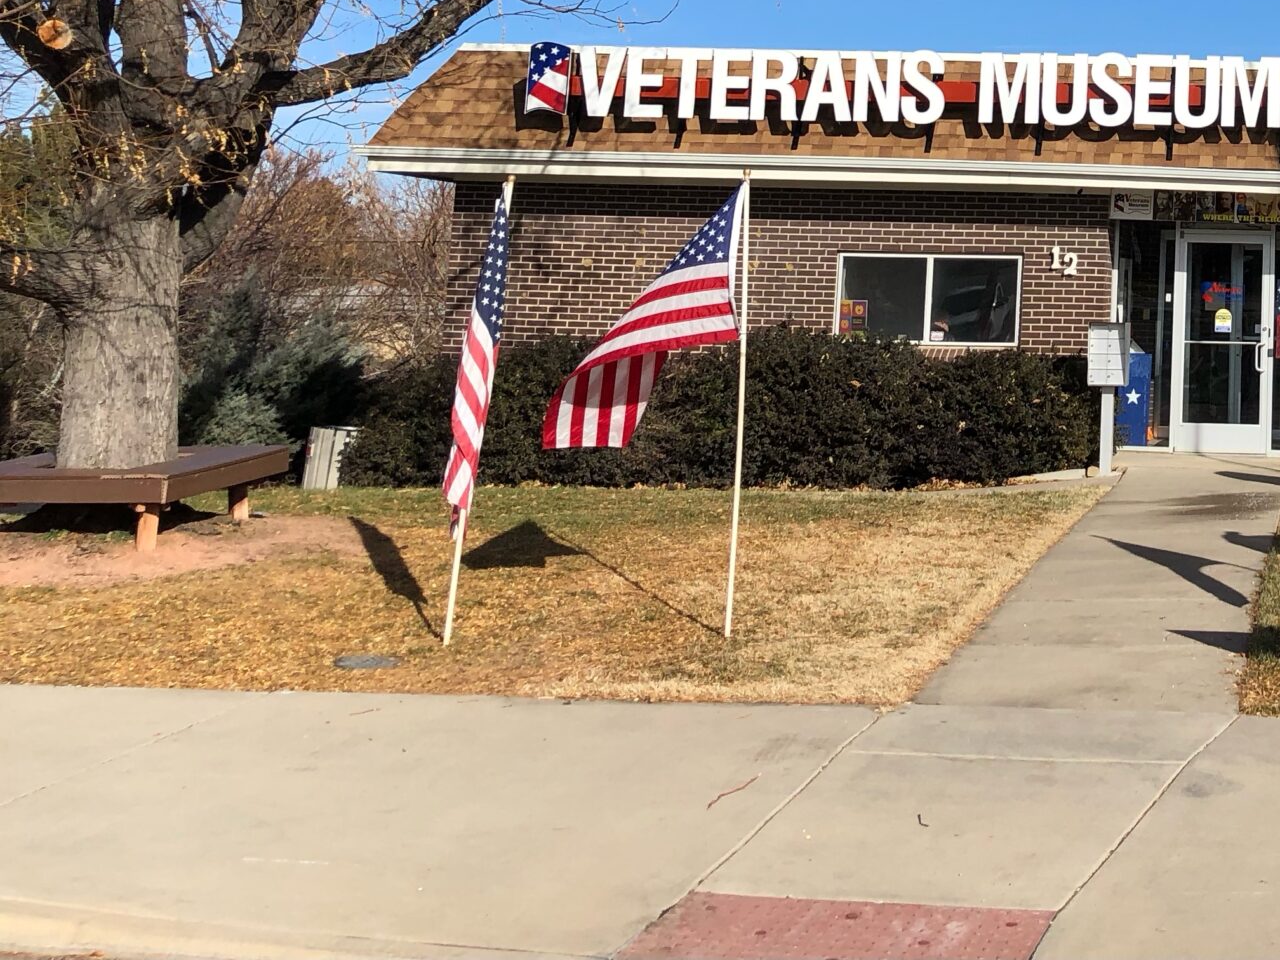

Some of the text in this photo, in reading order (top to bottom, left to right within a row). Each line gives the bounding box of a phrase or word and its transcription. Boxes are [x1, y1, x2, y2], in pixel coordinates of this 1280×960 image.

[576, 46, 945, 125] VETERANS
[1238, 215, 1256, 223] THE
[1051, 246, 1078, 276] 12
